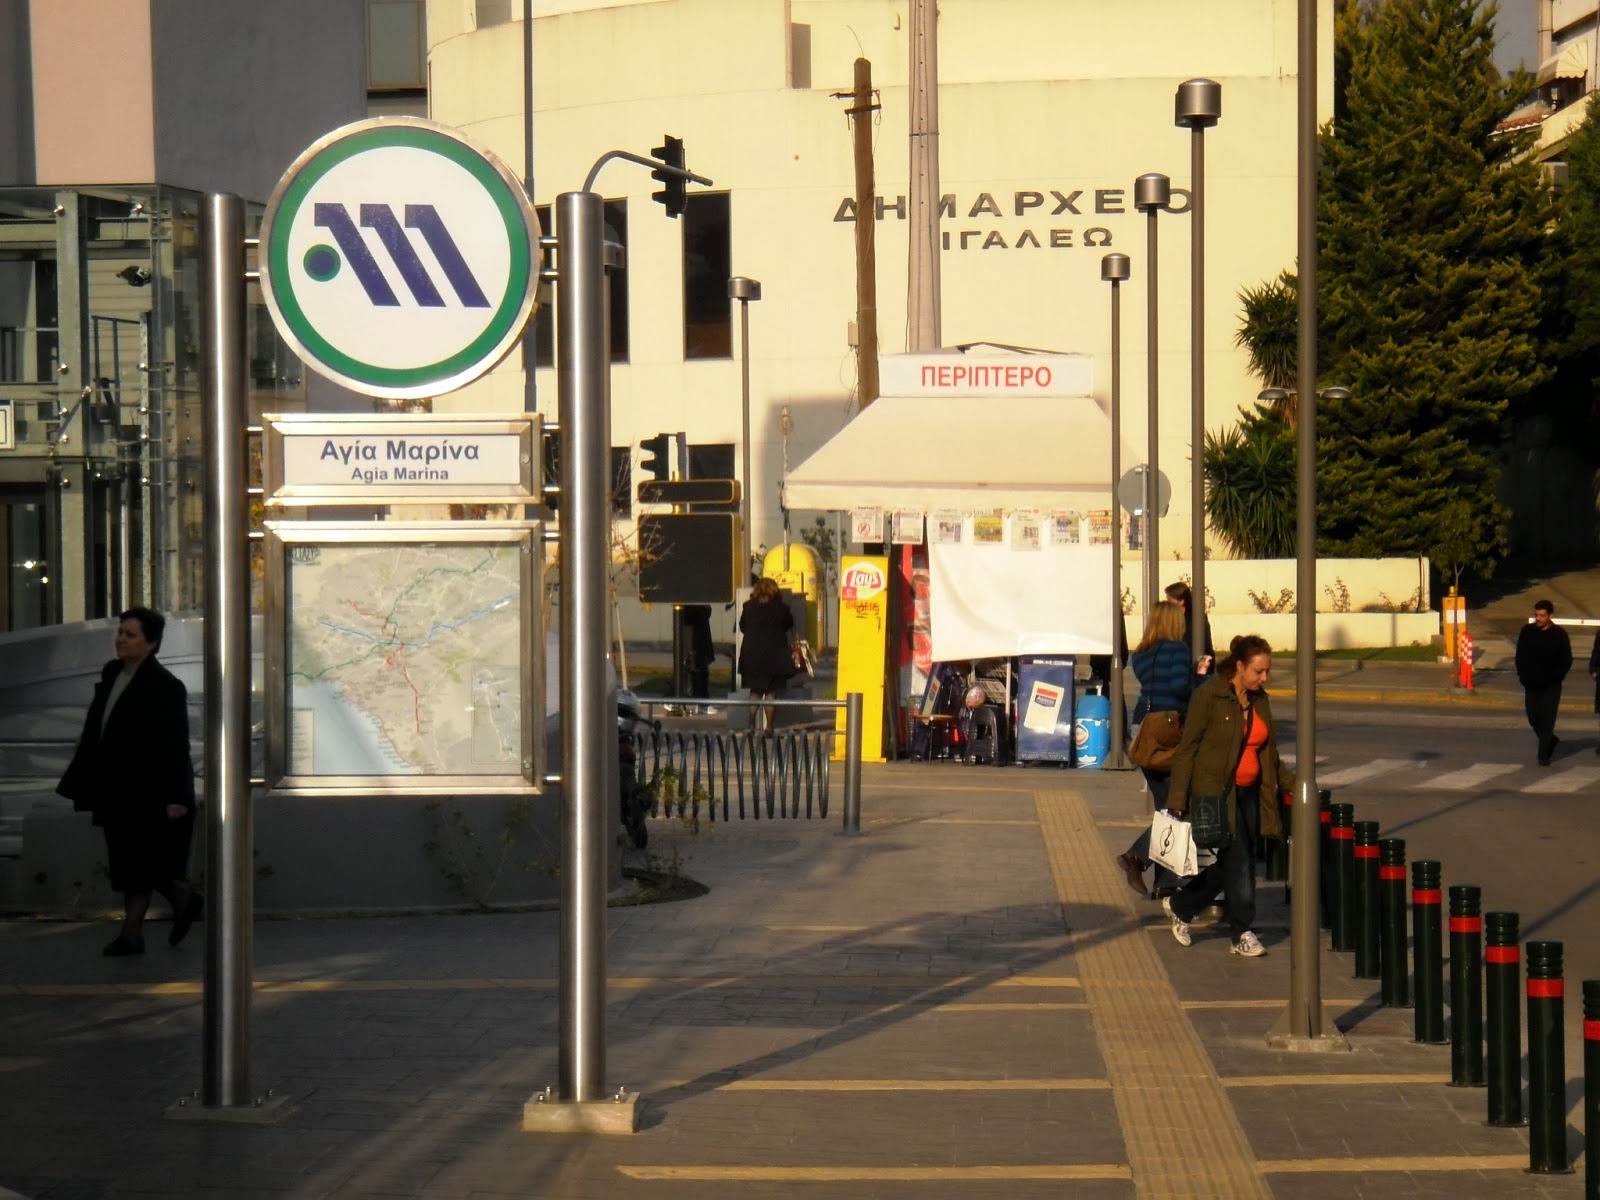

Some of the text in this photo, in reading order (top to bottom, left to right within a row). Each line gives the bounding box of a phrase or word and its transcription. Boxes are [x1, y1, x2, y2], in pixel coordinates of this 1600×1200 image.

[833, 188, 1192, 222] ΔΗΜΑΡΧΕΟ
[942, 227, 1113, 250] ΙΓΑΛΕΩ
[922, 366, 1052, 387] ΠΕΡΙΠΤΕΡΟ
[320, 440, 479, 465] Αγία Μαρίνα
[351, 467, 449, 484] Agia Marina
